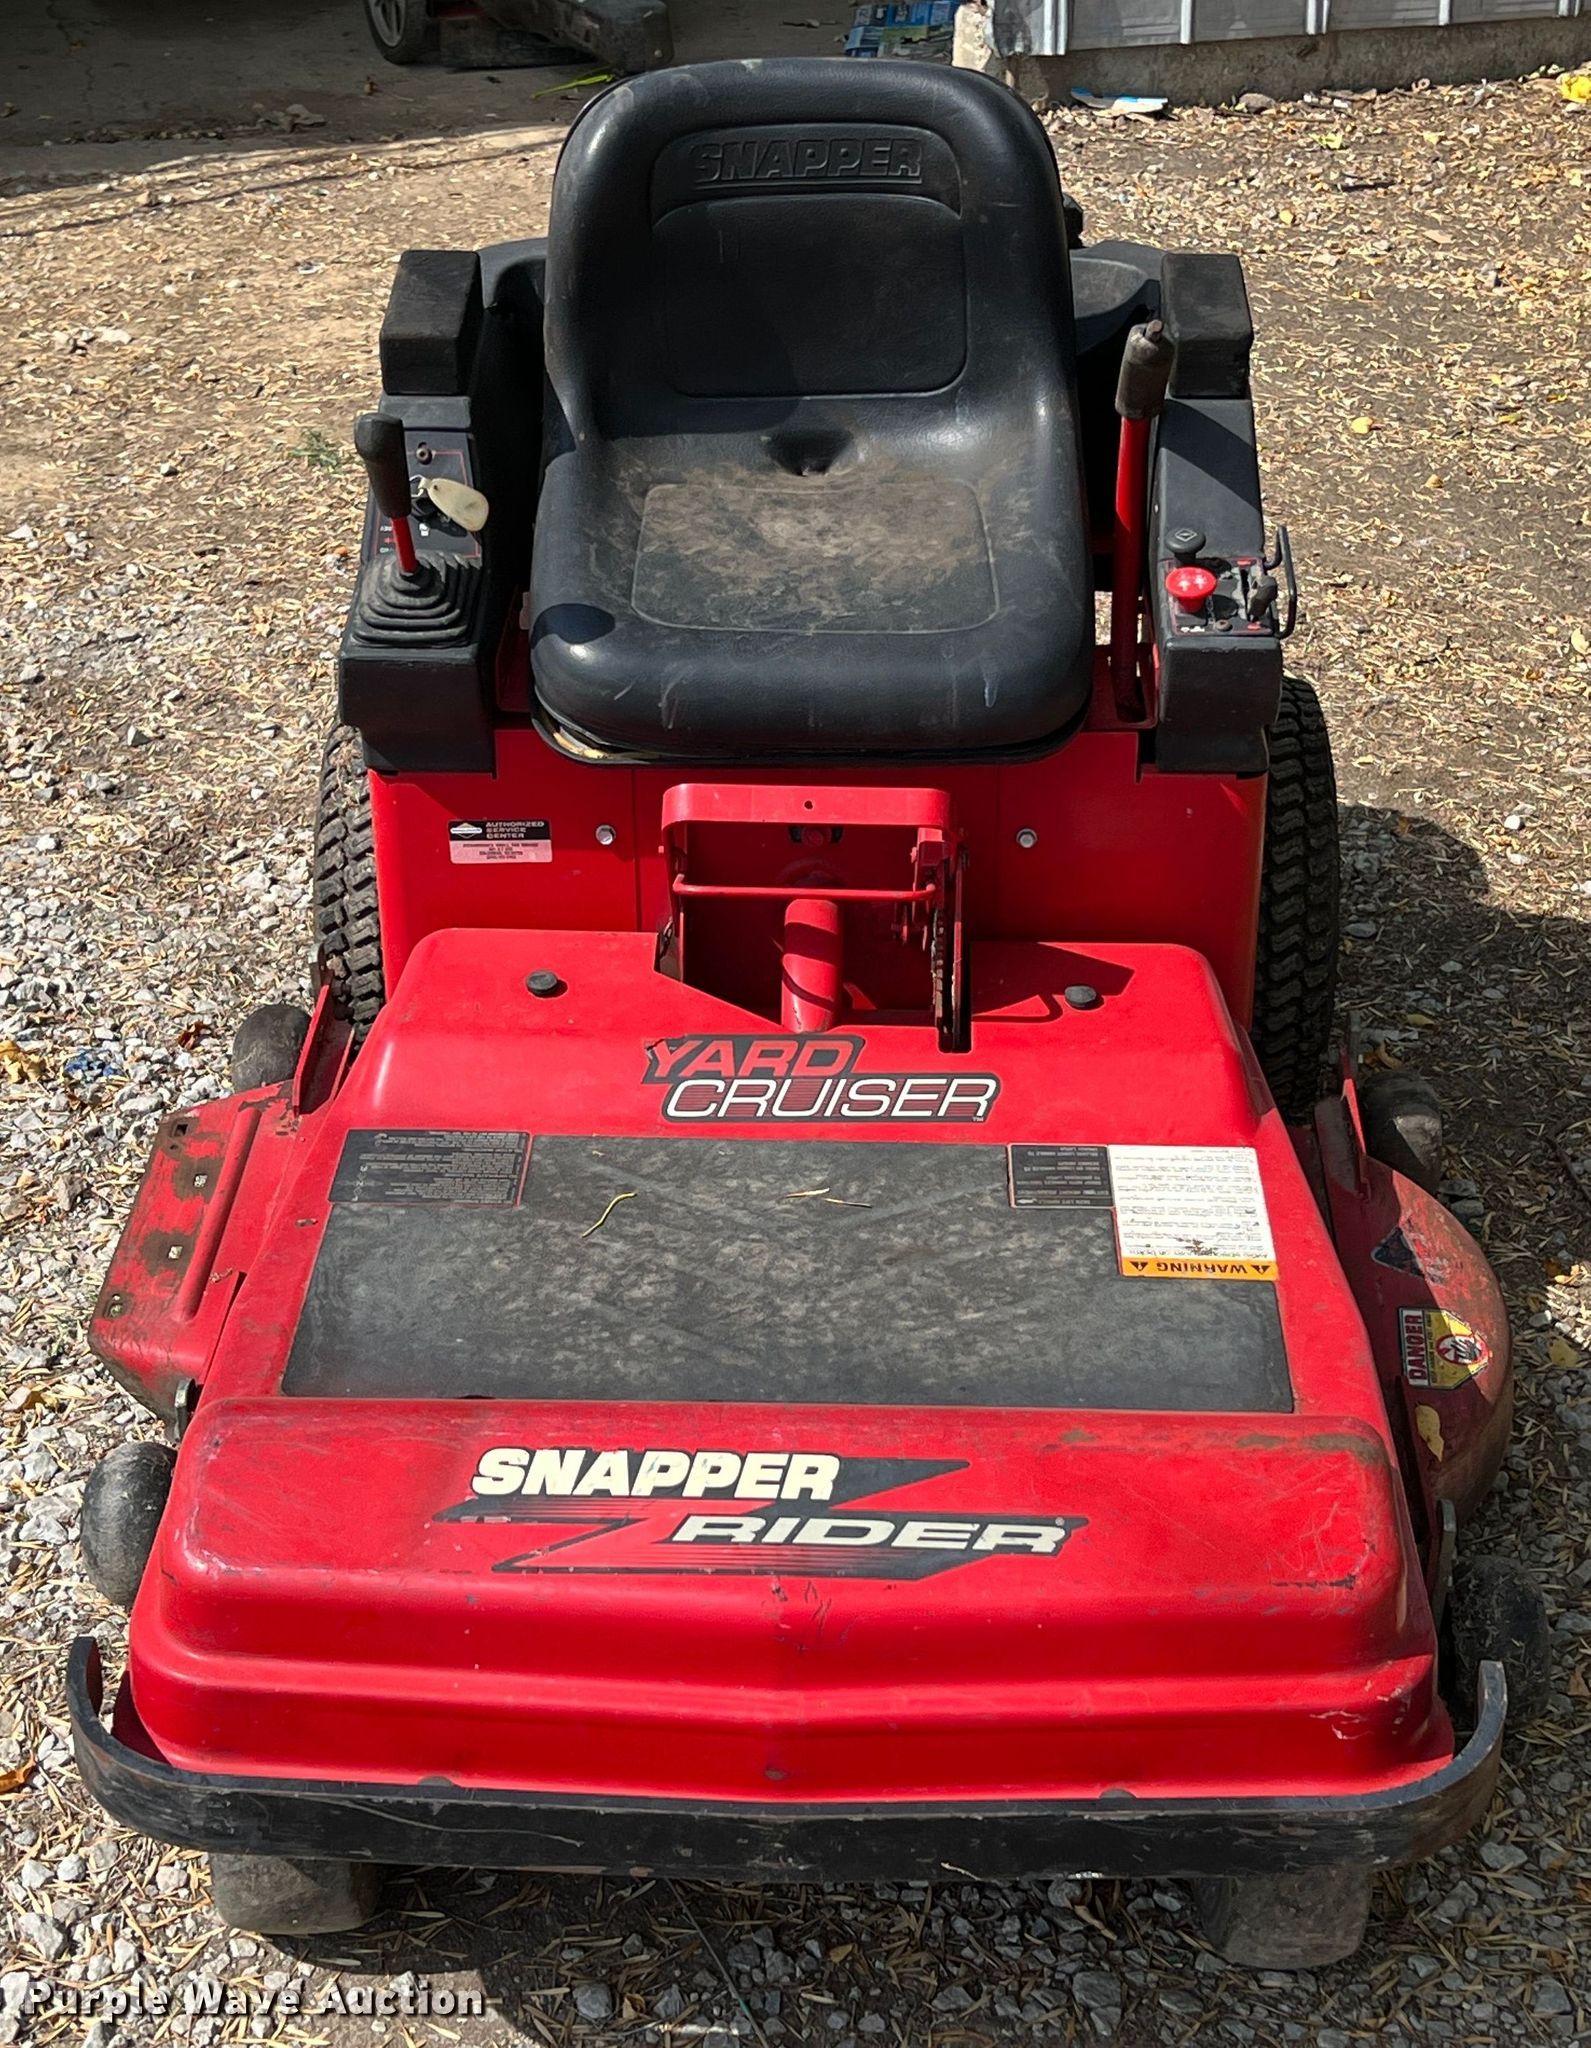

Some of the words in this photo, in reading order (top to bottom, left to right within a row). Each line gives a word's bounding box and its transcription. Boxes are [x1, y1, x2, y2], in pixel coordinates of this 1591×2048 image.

[690, 138, 922, 182] SNAPPER
[651, 1040, 855, 1077] YARD
[667, 1078, 997, 1118] CRUISER
[1156, 1261, 1248, 1274] WARNING
[1405, 1313, 1428, 1382] DANGER
[471, 1448, 840, 1500] SNAPPER
[672, 1514, 1067, 1554] RIDER
